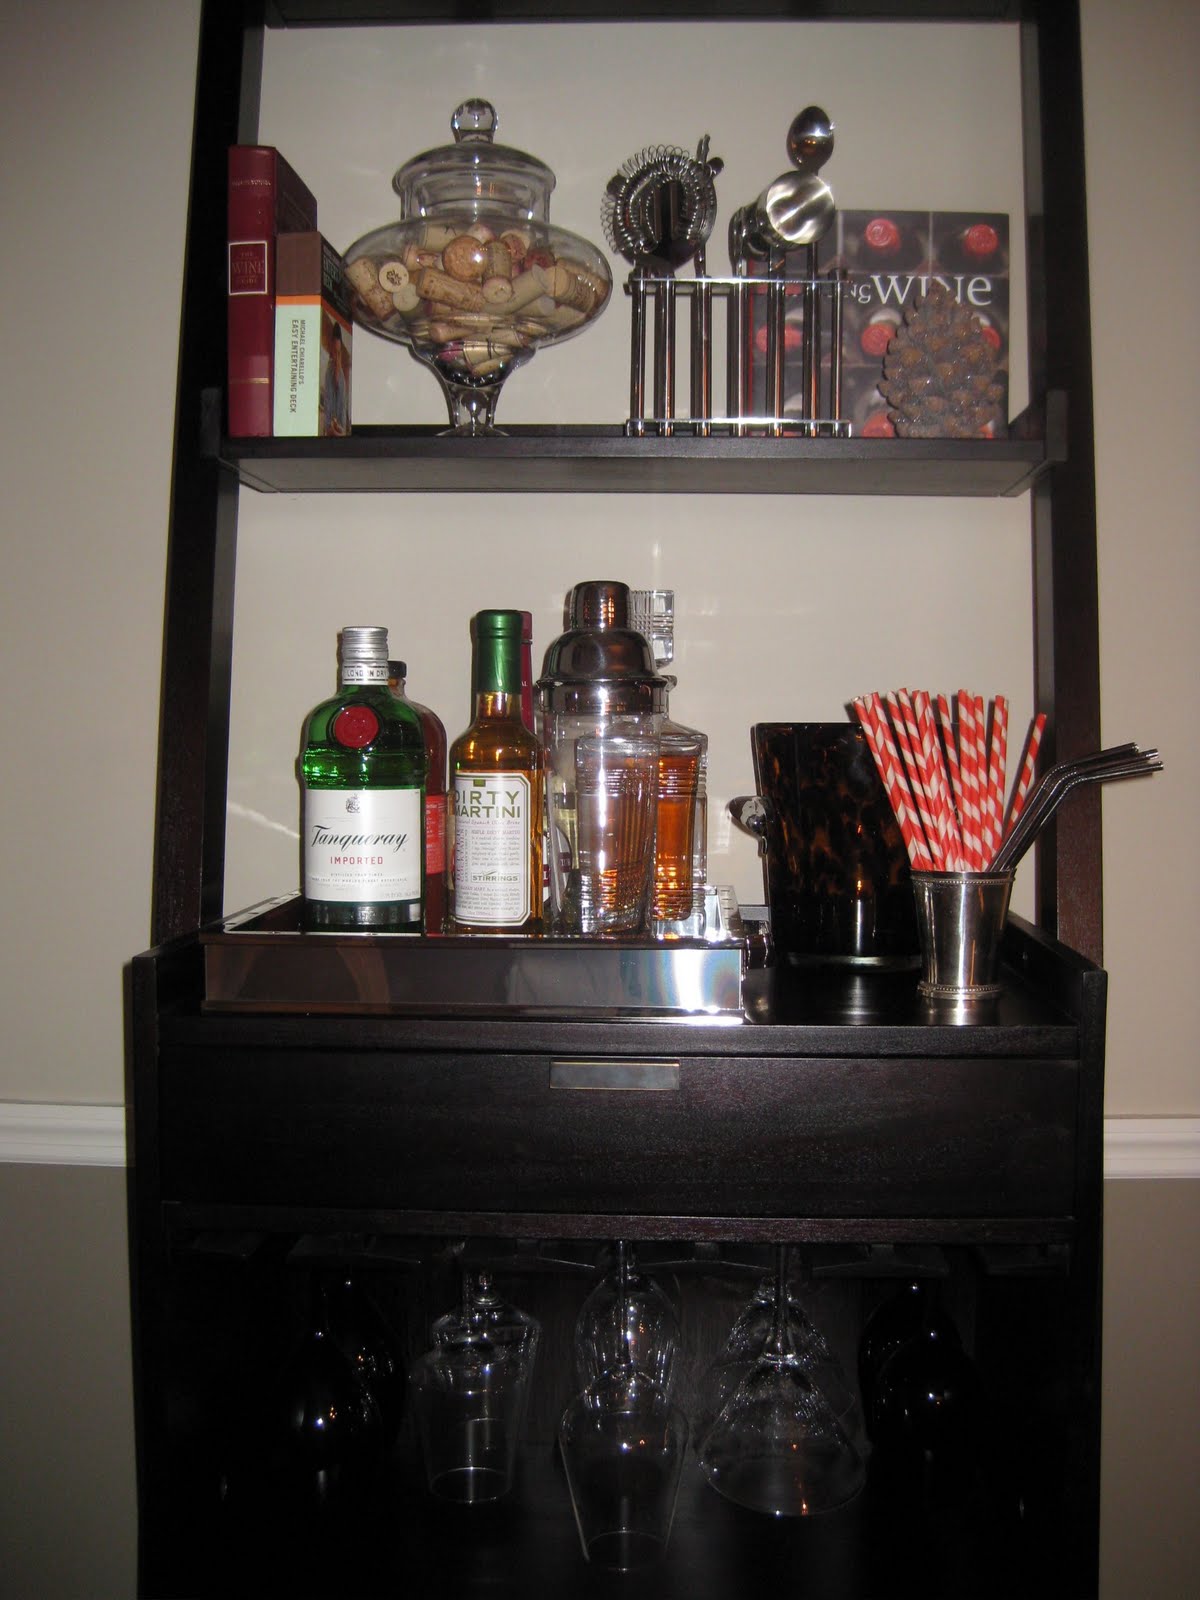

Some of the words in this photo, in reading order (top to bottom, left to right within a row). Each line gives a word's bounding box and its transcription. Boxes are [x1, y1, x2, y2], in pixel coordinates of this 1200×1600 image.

[233, 260, 265, 275] WINE
[291, 319, 299, 339] EASY
[290, 340, 298, 392] ENTERTAINING
[289, 394, 297, 413] DECK
[347, 669, 375, 677] LONDN
[455, 790, 520, 805] DIRTY
[311, 824, 408, 853] Tanqueray
[330, 856, 384, 865] IMPORTED
